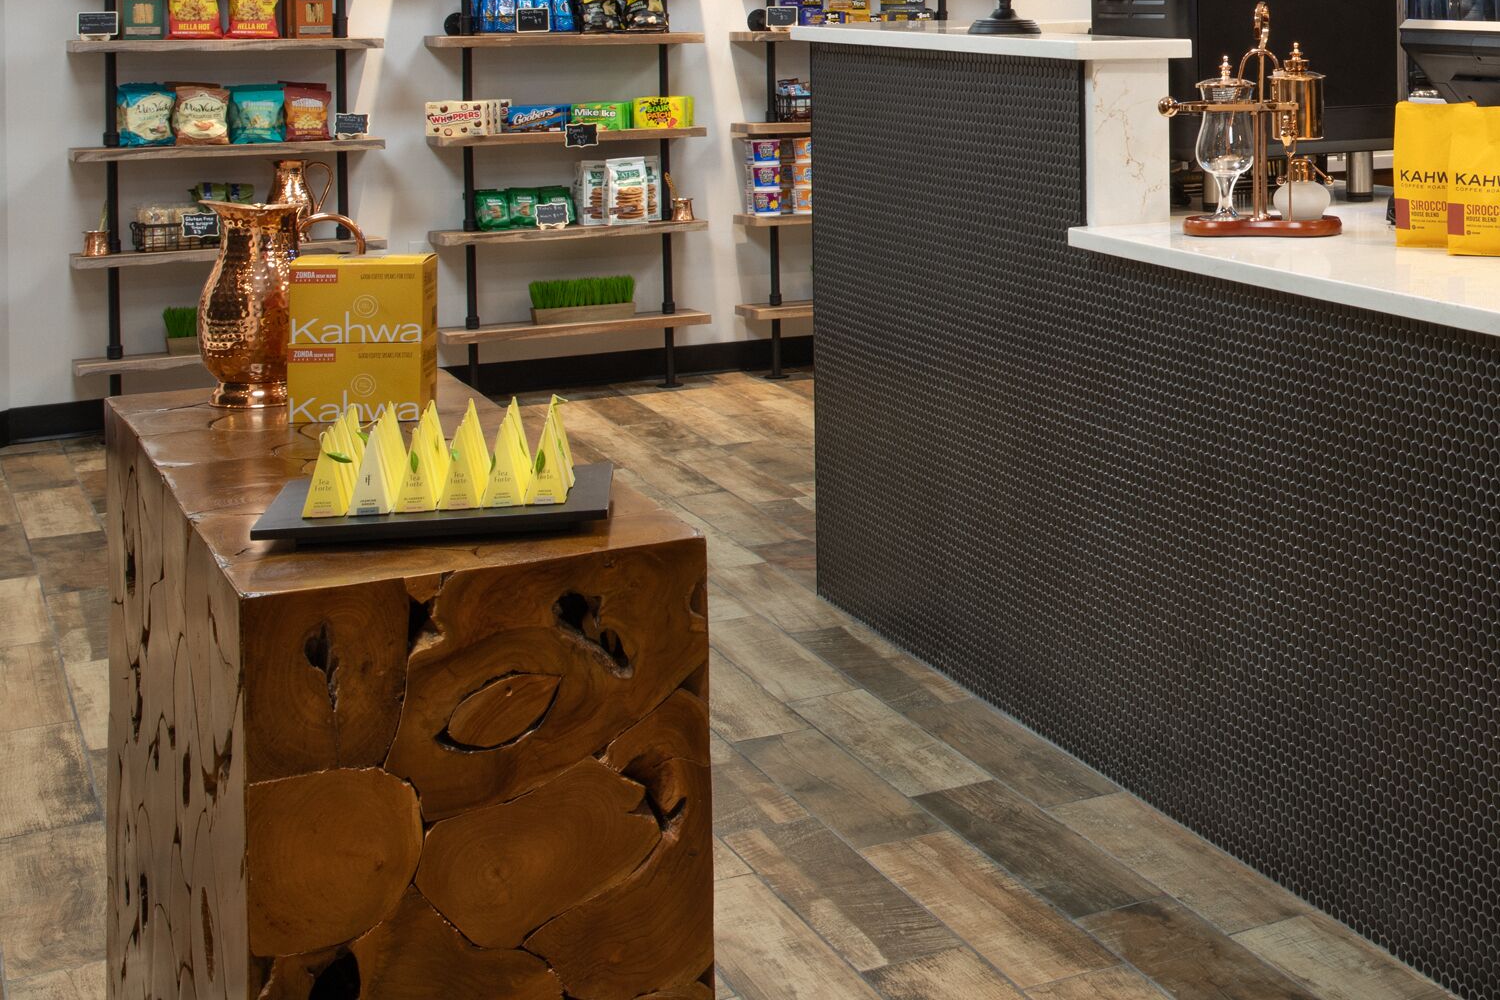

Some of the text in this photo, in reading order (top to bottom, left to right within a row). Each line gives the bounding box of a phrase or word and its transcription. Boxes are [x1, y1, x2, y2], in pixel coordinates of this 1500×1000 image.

[826, 12, 839, 20] 1st
[574, 108, 616, 117] Mike Ike
[647, 104, 670, 112] SOUR
[431, 110, 480, 124] WHOPPERS
[512, 108, 555, 125] Goobers
[646, 111, 671, 119] PATCH
[1400, 169, 1448, 184] KAHW
[1411, 200, 1448, 212] SIROCCO
[295, 271, 316, 279] ZONDA
[291, 311, 423, 344] Kahwa
[289, 389, 419, 424] Kahwa
